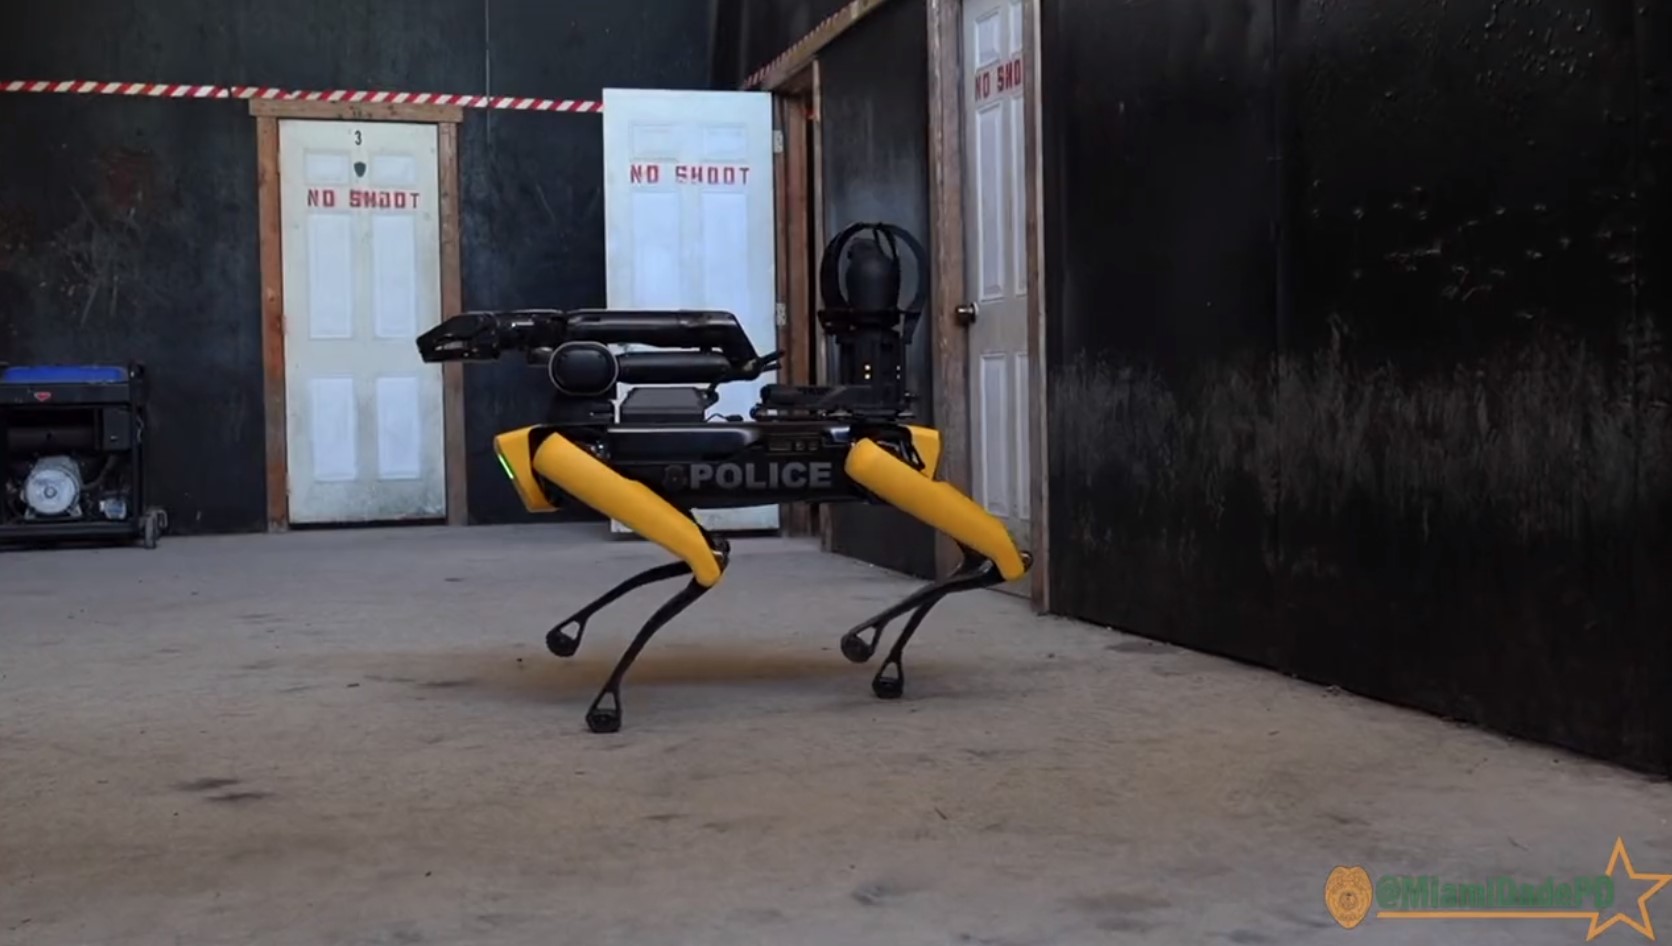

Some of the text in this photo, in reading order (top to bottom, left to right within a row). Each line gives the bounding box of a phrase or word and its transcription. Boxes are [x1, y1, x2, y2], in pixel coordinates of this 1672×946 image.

[354, 130, 363, 146] 3
[629, 164, 750, 185] NO SHOOT
[307, 189, 420, 209] NO SHOOT
[689, 462, 832, 489] POLICE
